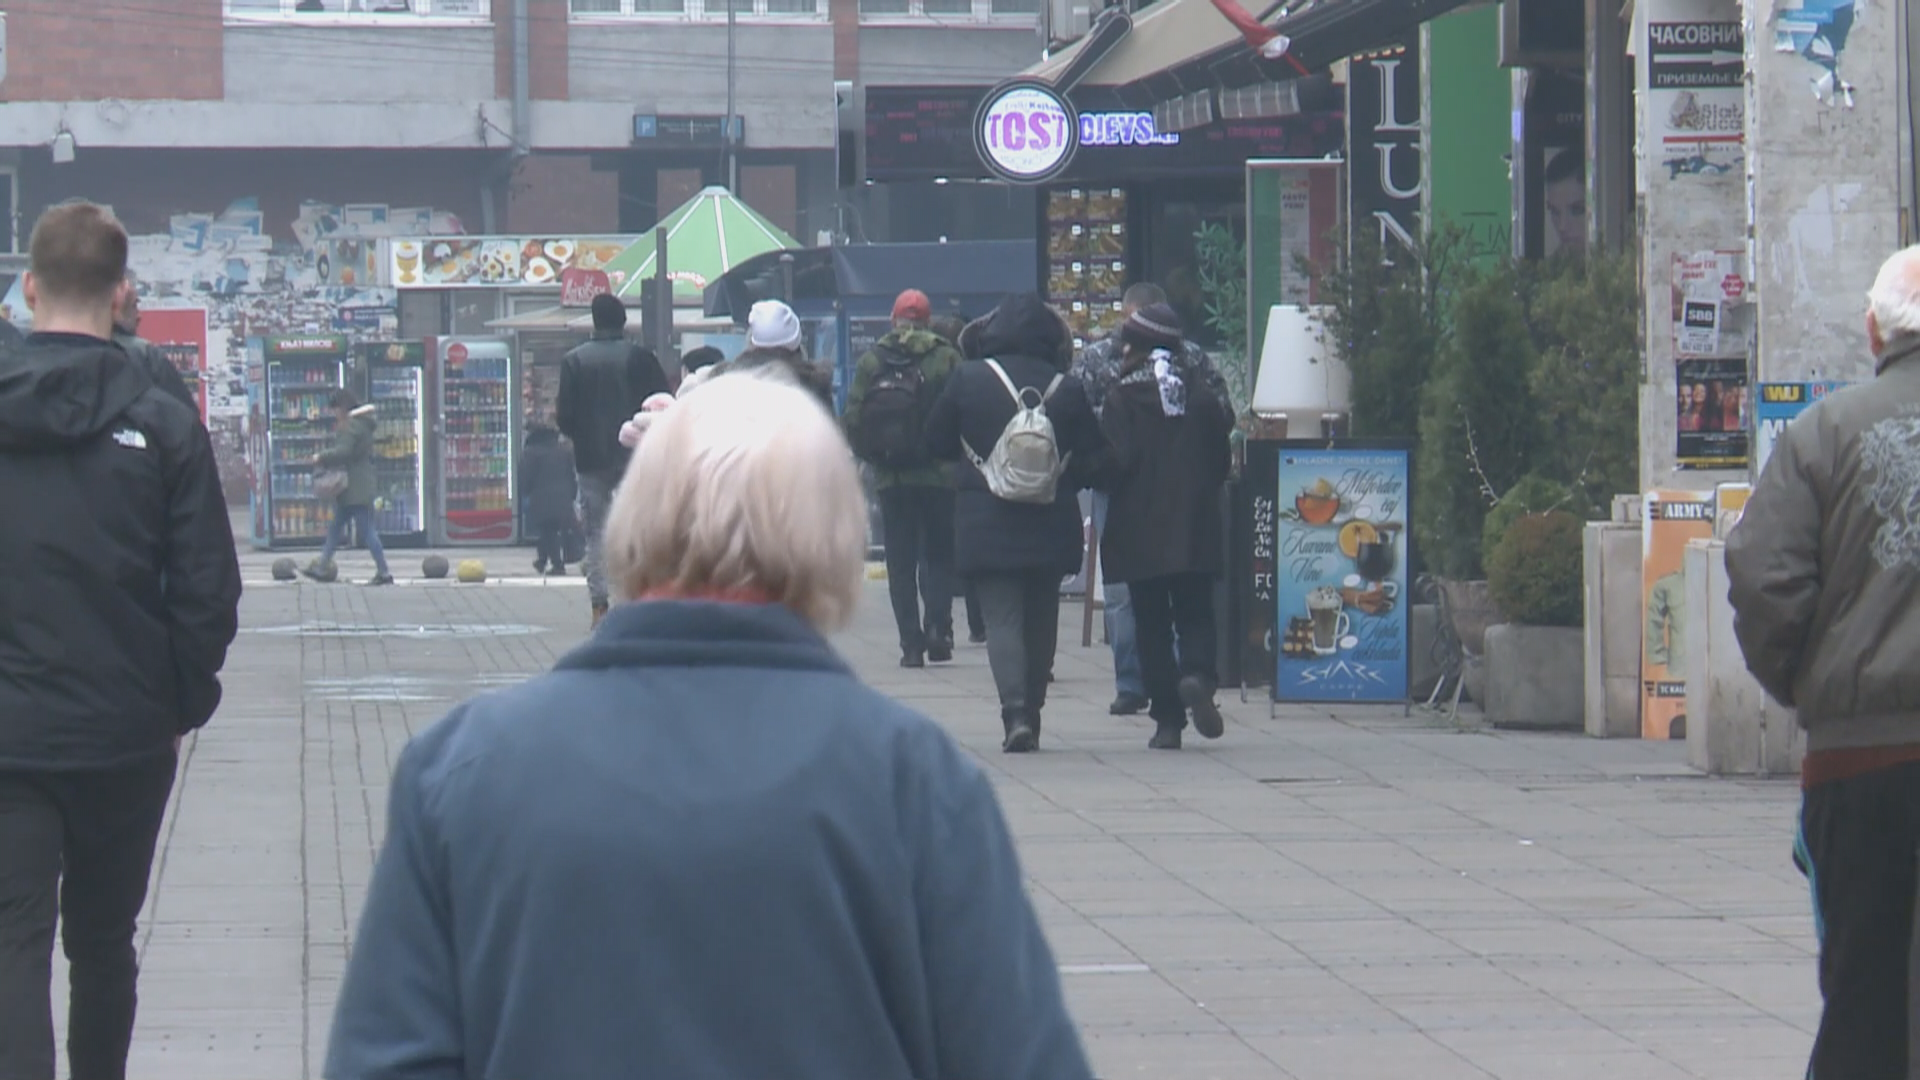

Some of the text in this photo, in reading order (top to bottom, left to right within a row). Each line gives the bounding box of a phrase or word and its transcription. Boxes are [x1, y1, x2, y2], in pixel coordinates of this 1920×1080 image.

[989, 112, 1065, 151] TOST
[1688, 310, 1713, 321] SBB
[1764, 386, 1799, 401] WU
[1664, 503, 1703, 518] ARMY
